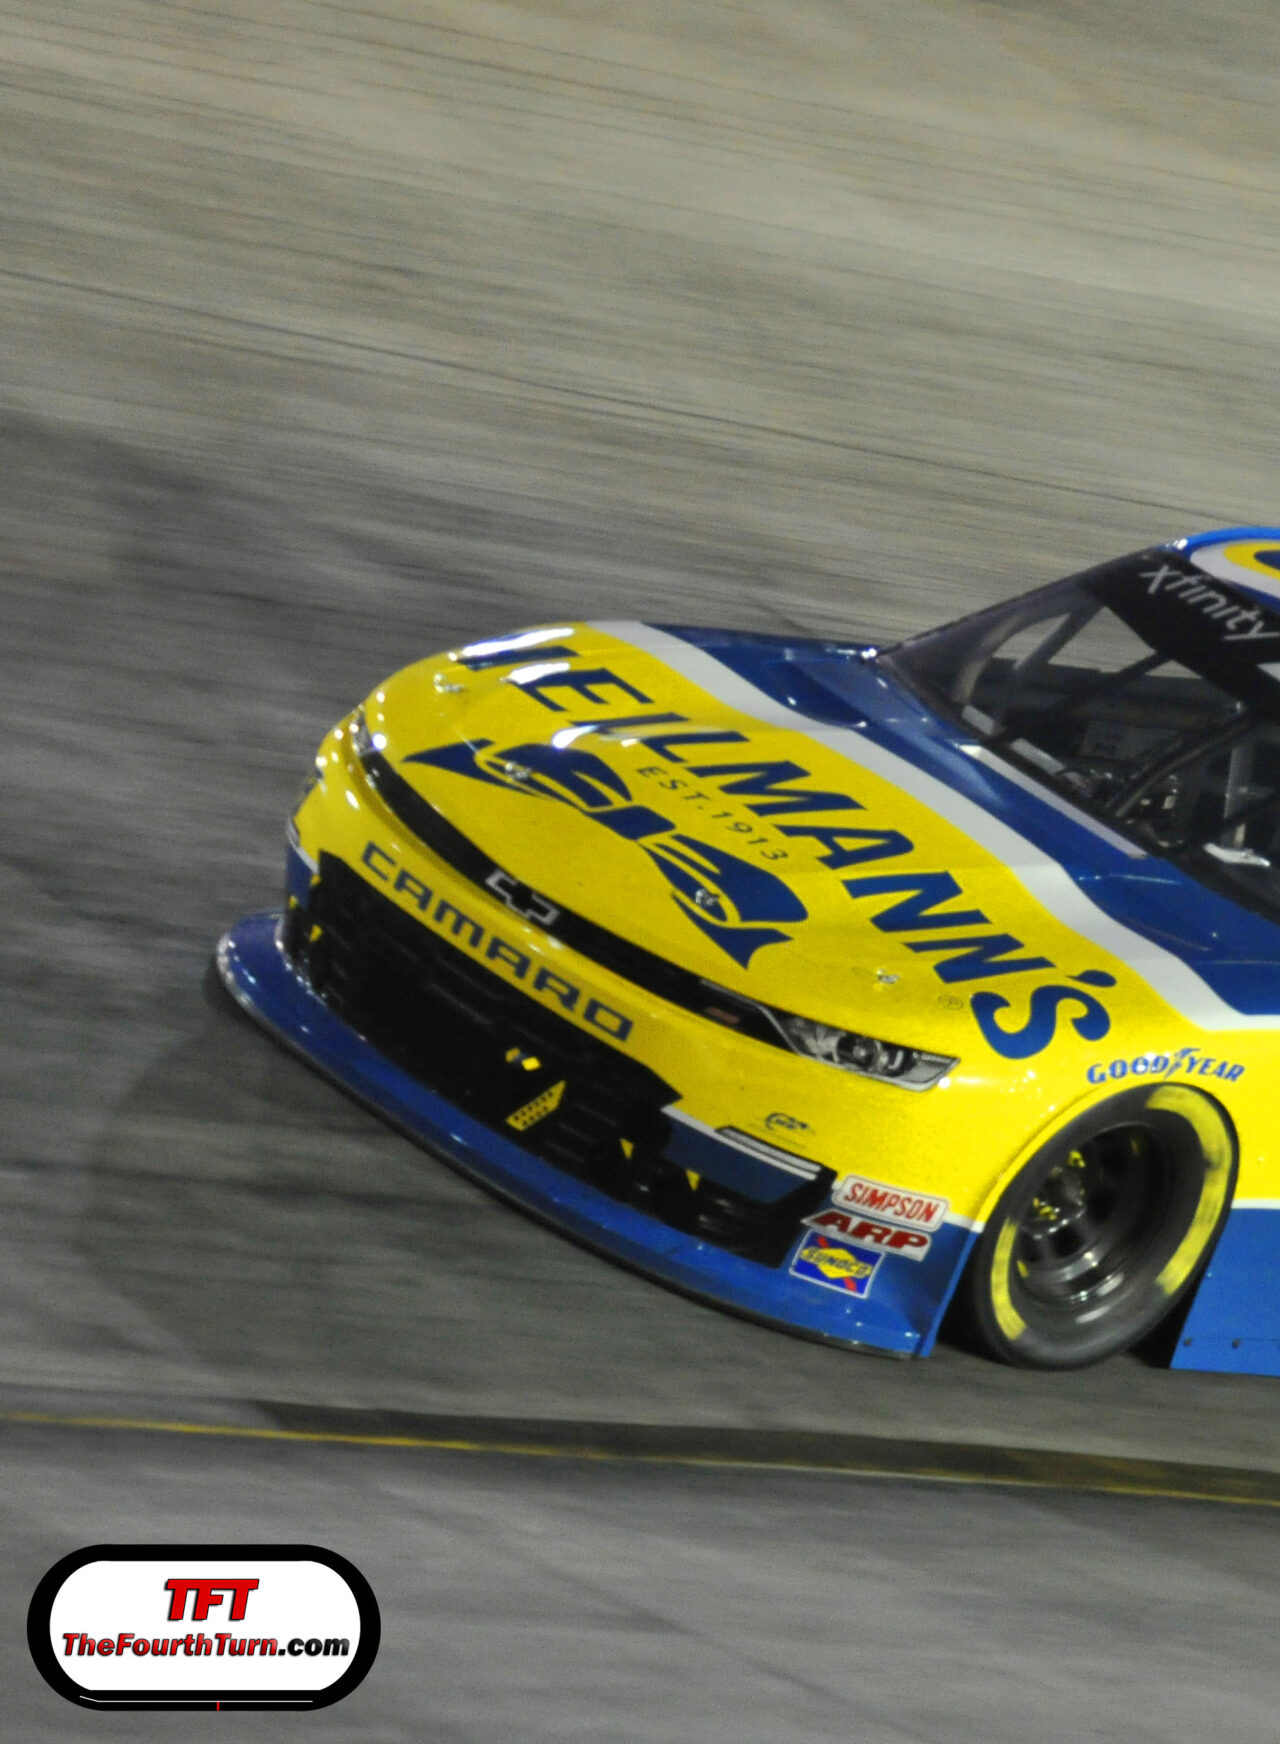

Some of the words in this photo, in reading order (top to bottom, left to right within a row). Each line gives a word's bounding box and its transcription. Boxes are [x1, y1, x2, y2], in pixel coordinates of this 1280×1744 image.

[362, 842, 634, 1043] CAMARO
[845, 1182, 940, 1223] SIMPSON
[813, 1209, 910, 1250] ARP
[802, 1246, 873, 1278] SUNOCO
